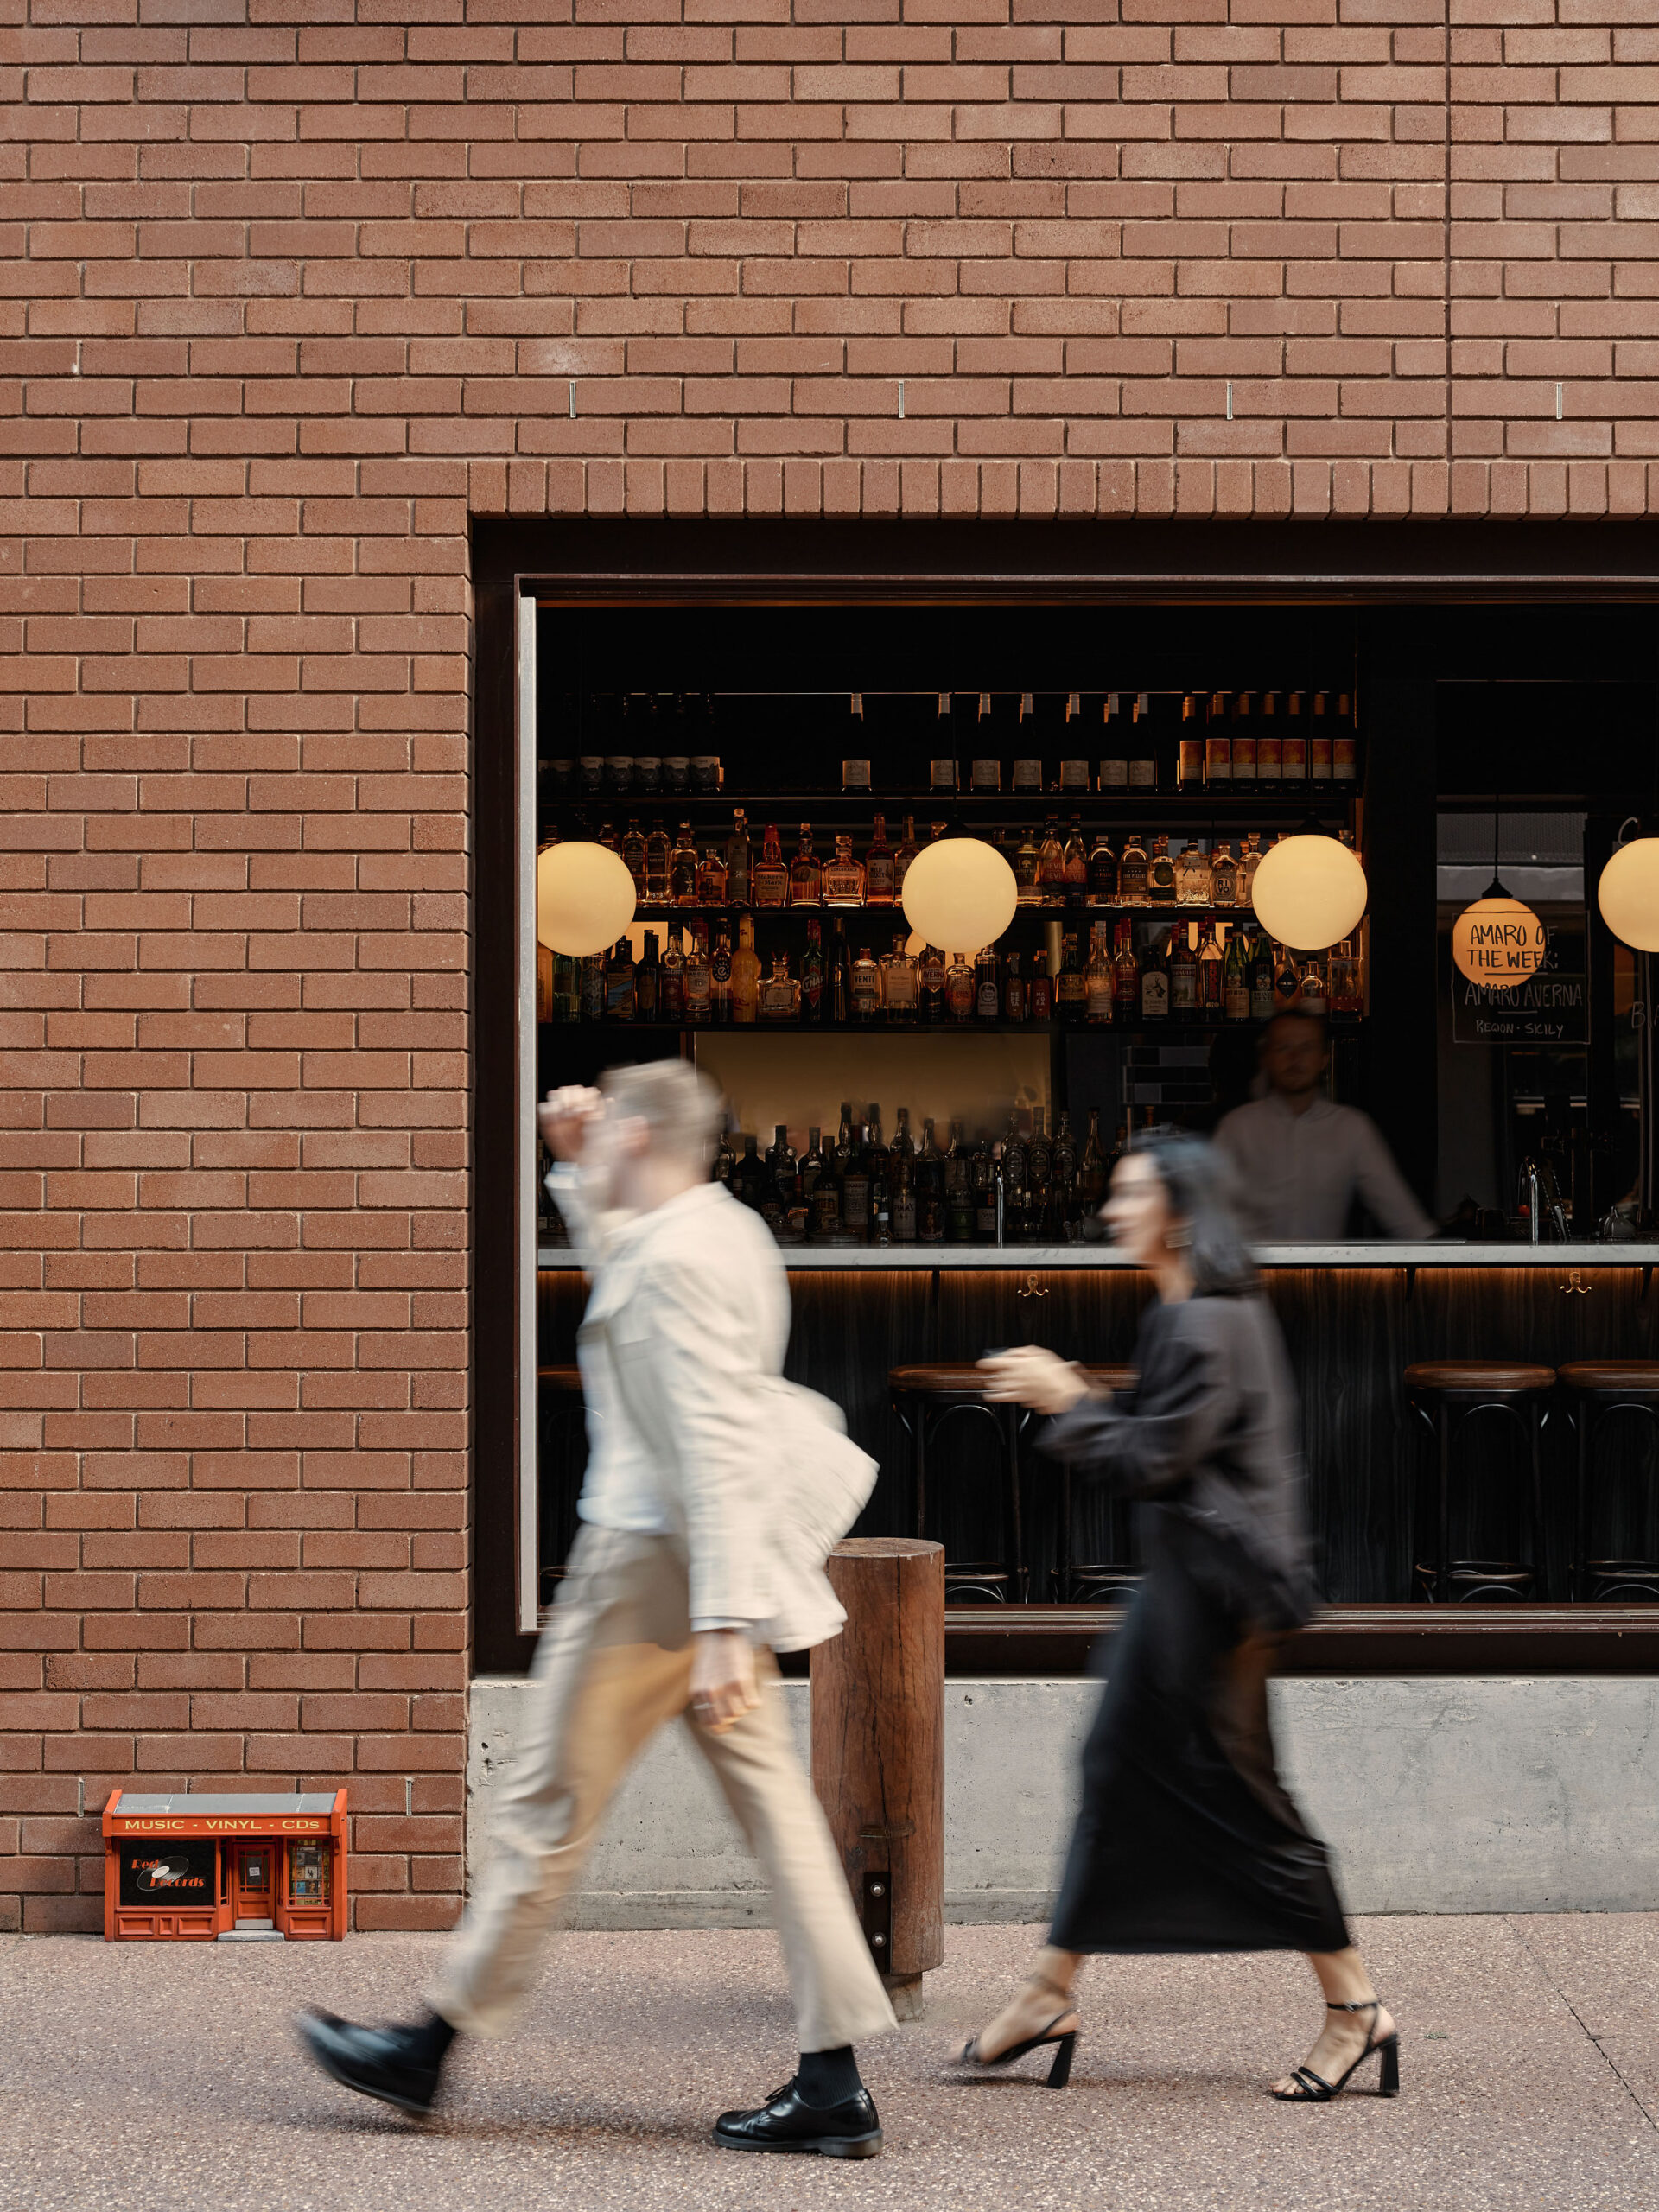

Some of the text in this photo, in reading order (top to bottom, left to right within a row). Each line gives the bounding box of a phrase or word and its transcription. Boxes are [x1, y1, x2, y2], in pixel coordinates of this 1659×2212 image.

[1471, 925, 1559, 946] AMARO OF
[1466, 950, 1559, 969] THE WEEK:
[855, 975, 874, 983] VENTI
[1465, 982, 1583, 1007] AMARO AVERNA
[1524, 1023, 1564, 1039] SICILY
[125, 1820, 185, 1829] MUSIC
[205, 1820, 262, 1829] VINYL
[282, 1820, 320, 1829] CDs
[131, 1859, 159, 1869] Red
[149, 1877, 205, 1887] Records
